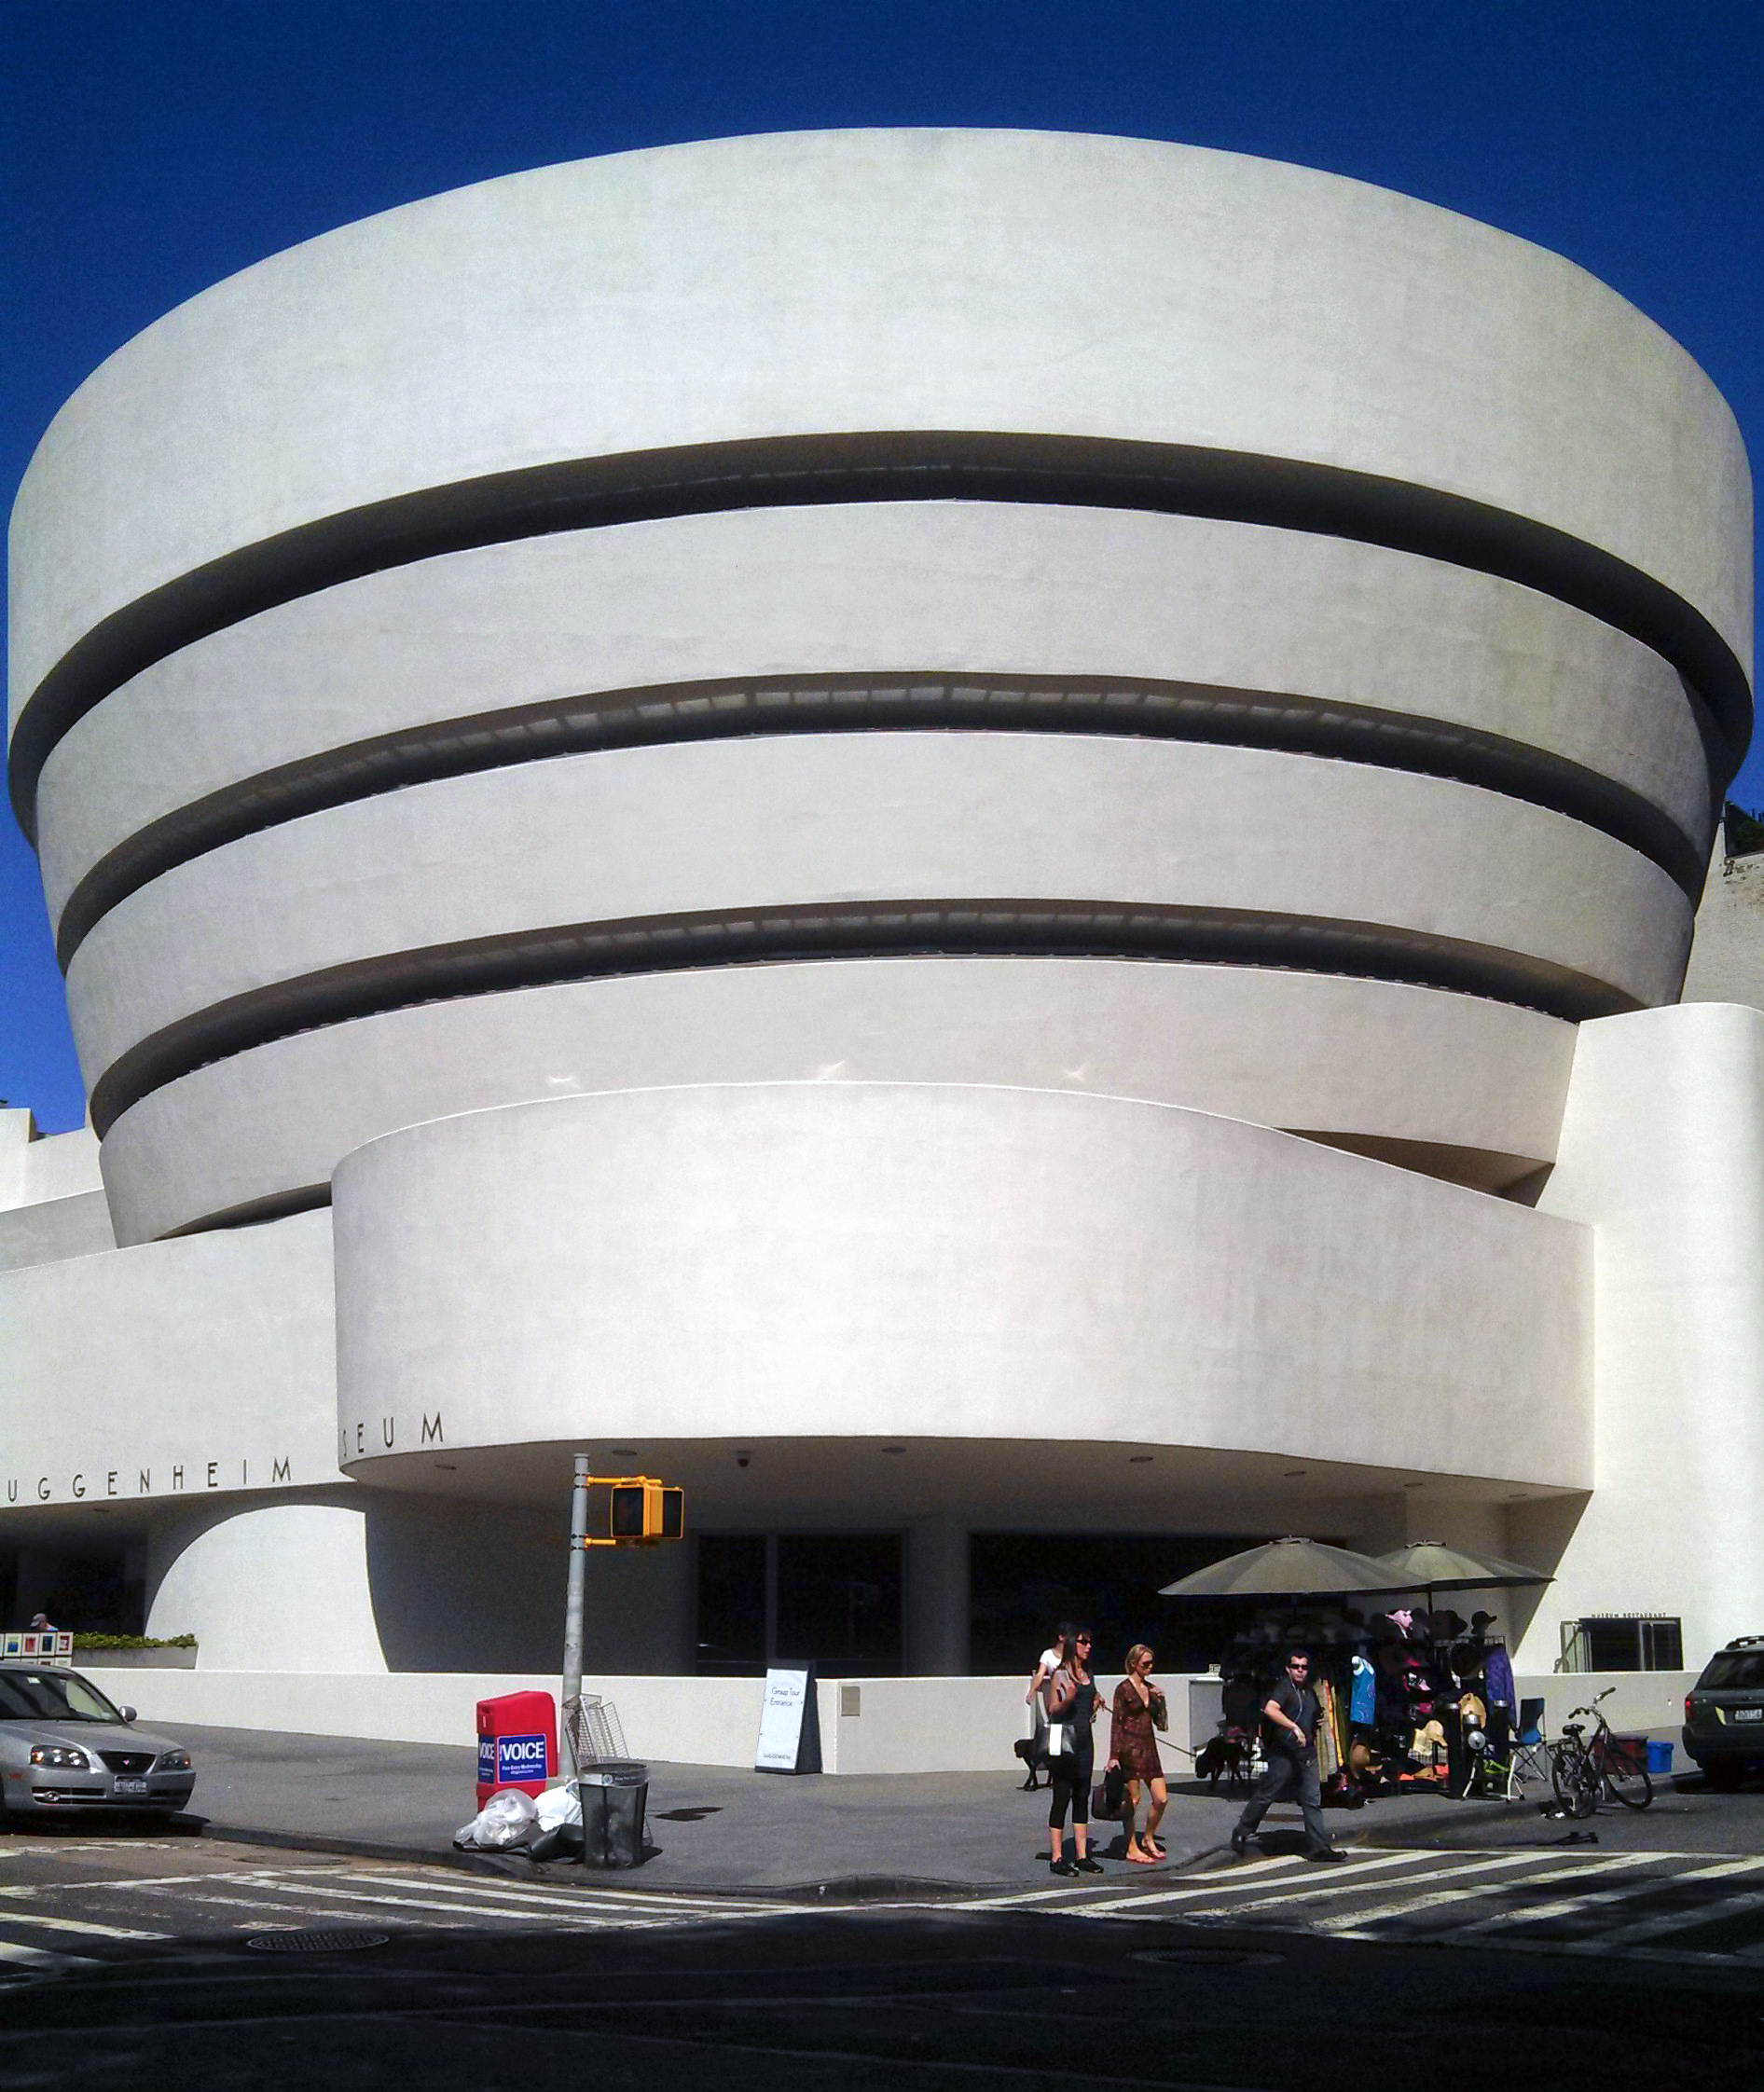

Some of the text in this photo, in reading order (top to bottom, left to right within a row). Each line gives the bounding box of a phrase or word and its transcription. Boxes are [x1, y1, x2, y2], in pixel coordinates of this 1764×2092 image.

[7, 1456, 292, 1503] UGGENHEIM
[772, 1686, 800, 1697] Group Tour
[770, 1697, 792, 1707] Entrance
[478, 1741, 495, 1761] VOICE
[502, 1741, 544, 1761] VOICE
